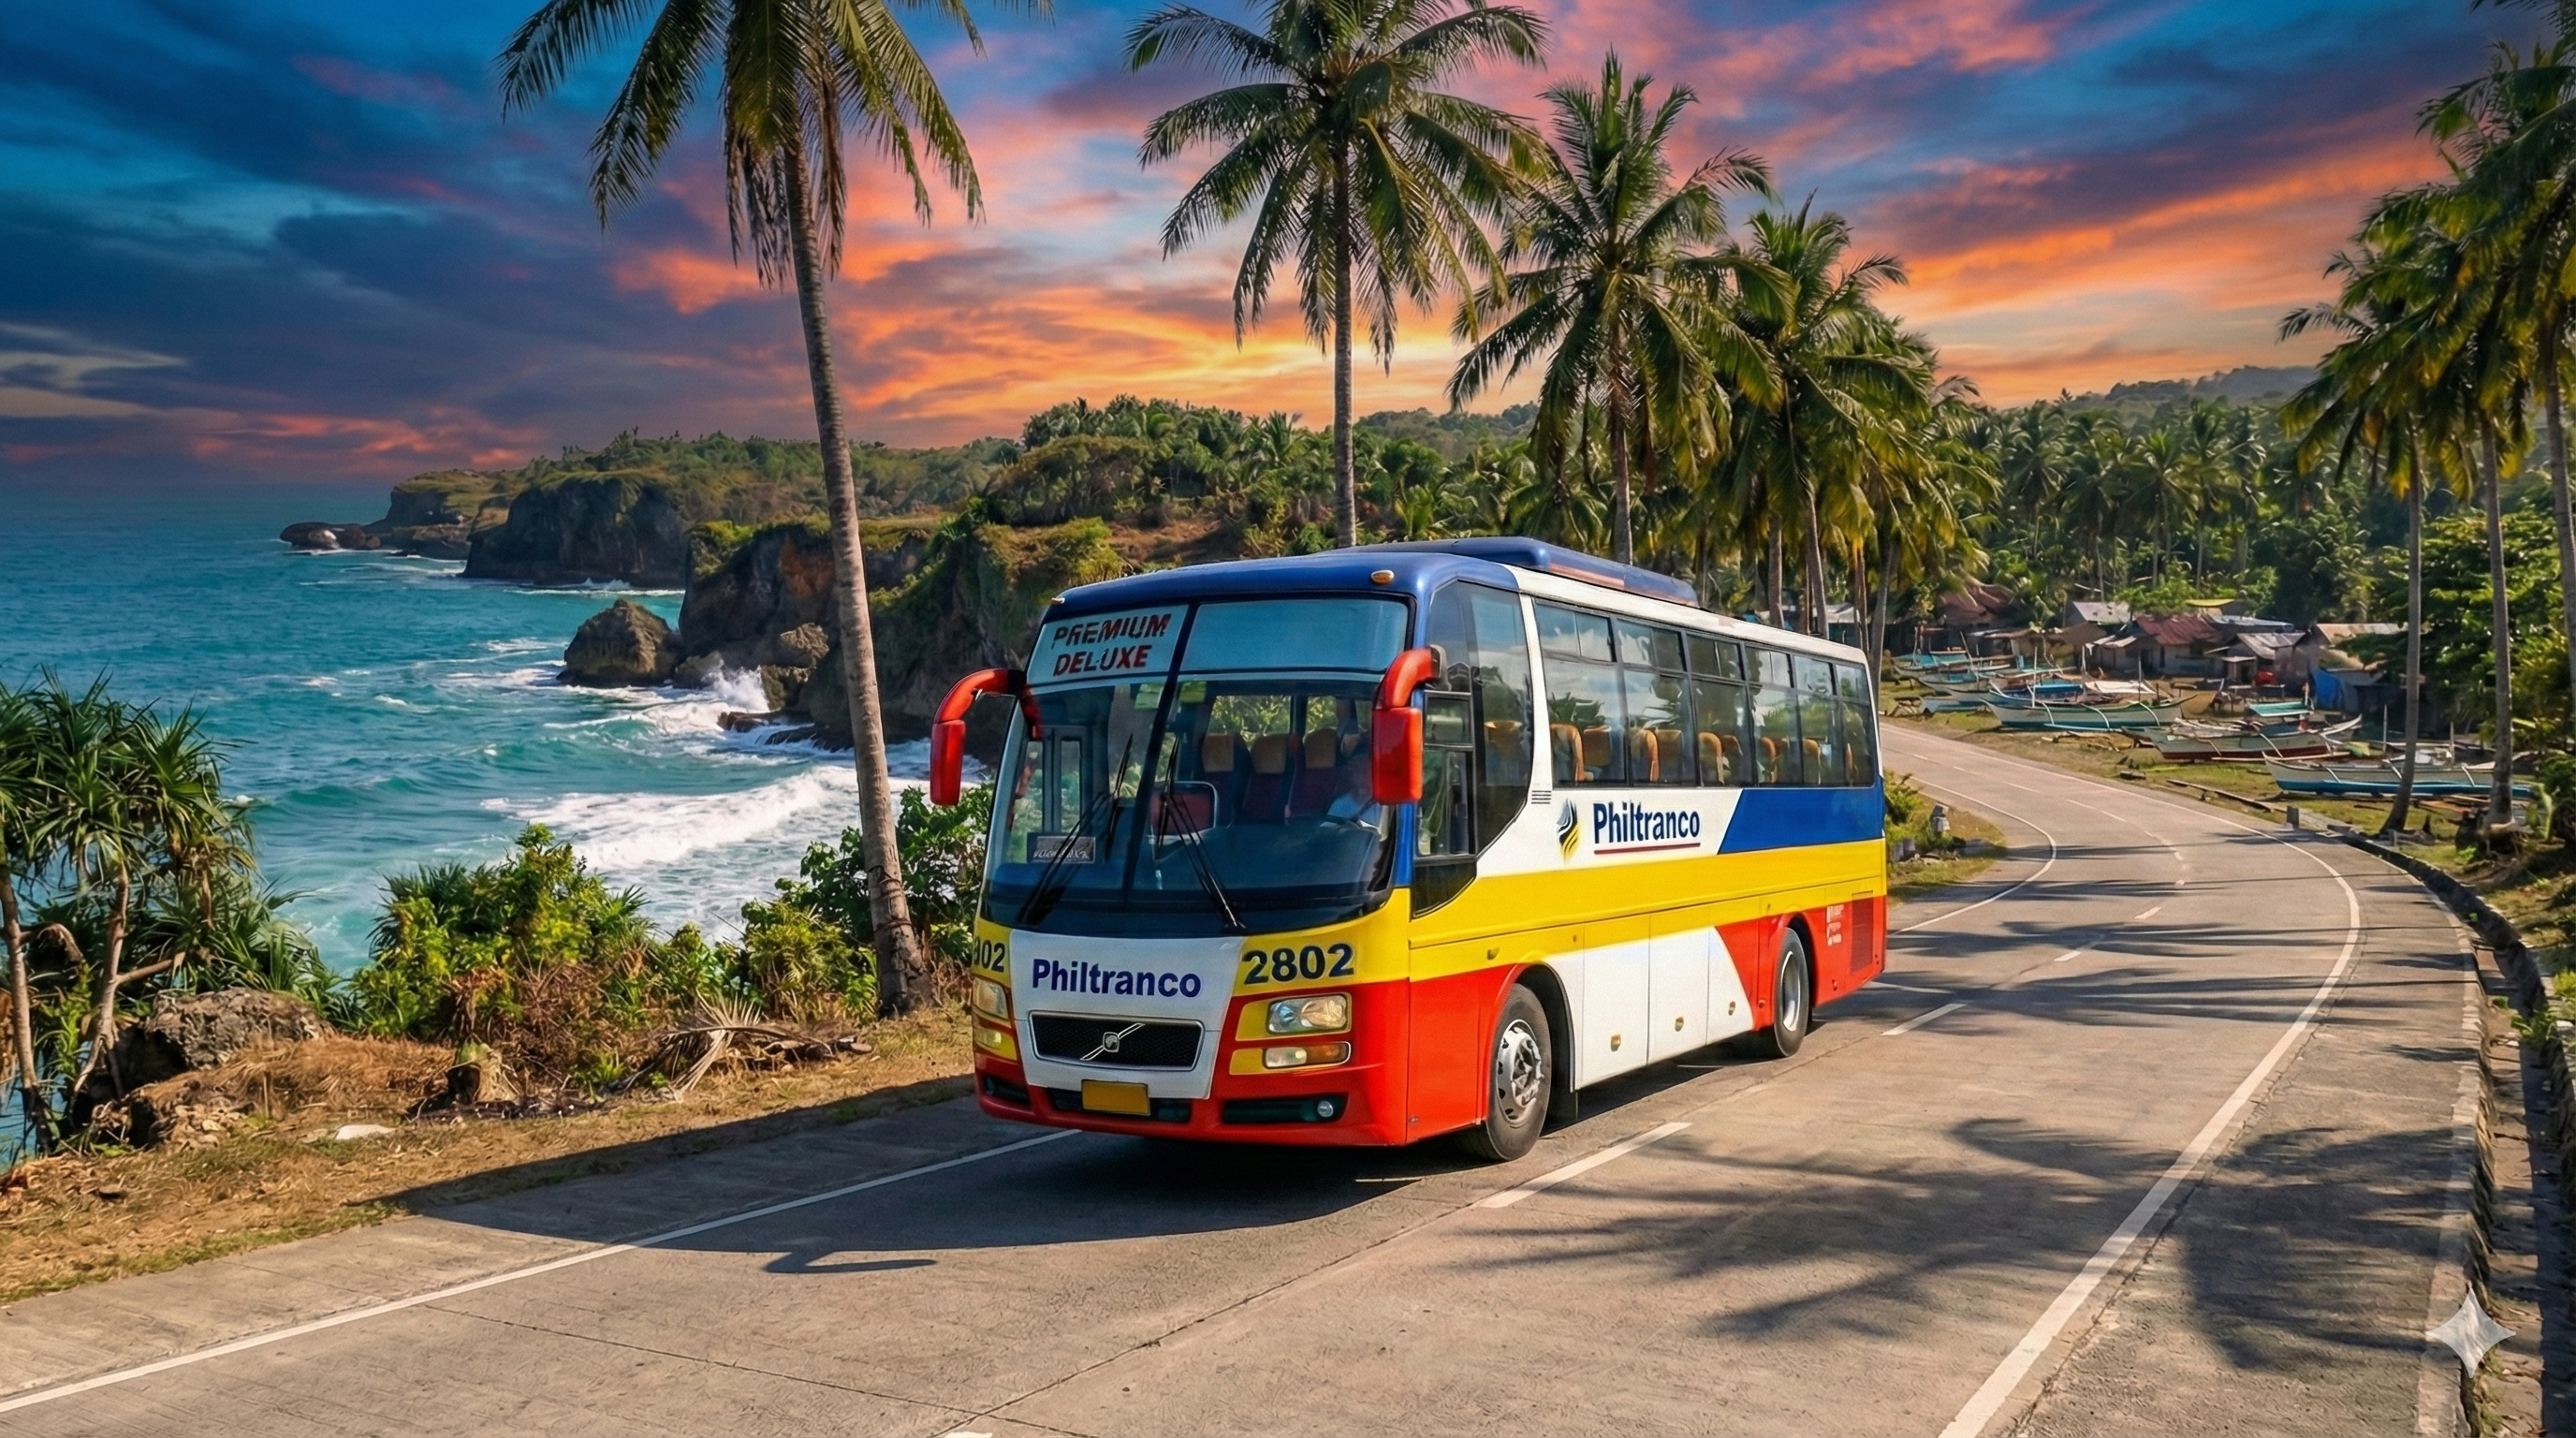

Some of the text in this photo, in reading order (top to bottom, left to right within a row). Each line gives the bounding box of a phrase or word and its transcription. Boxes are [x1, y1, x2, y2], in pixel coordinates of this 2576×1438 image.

[1052, 614, 1171, 649] PREMIUM
[1053, 645, 1151, 676] DELUXE
[1592, 800, 1701, 844] Philtranco
[1032, 959, 1201, 998] Philtranco
[1241, 943, 1354, 985] 2802
